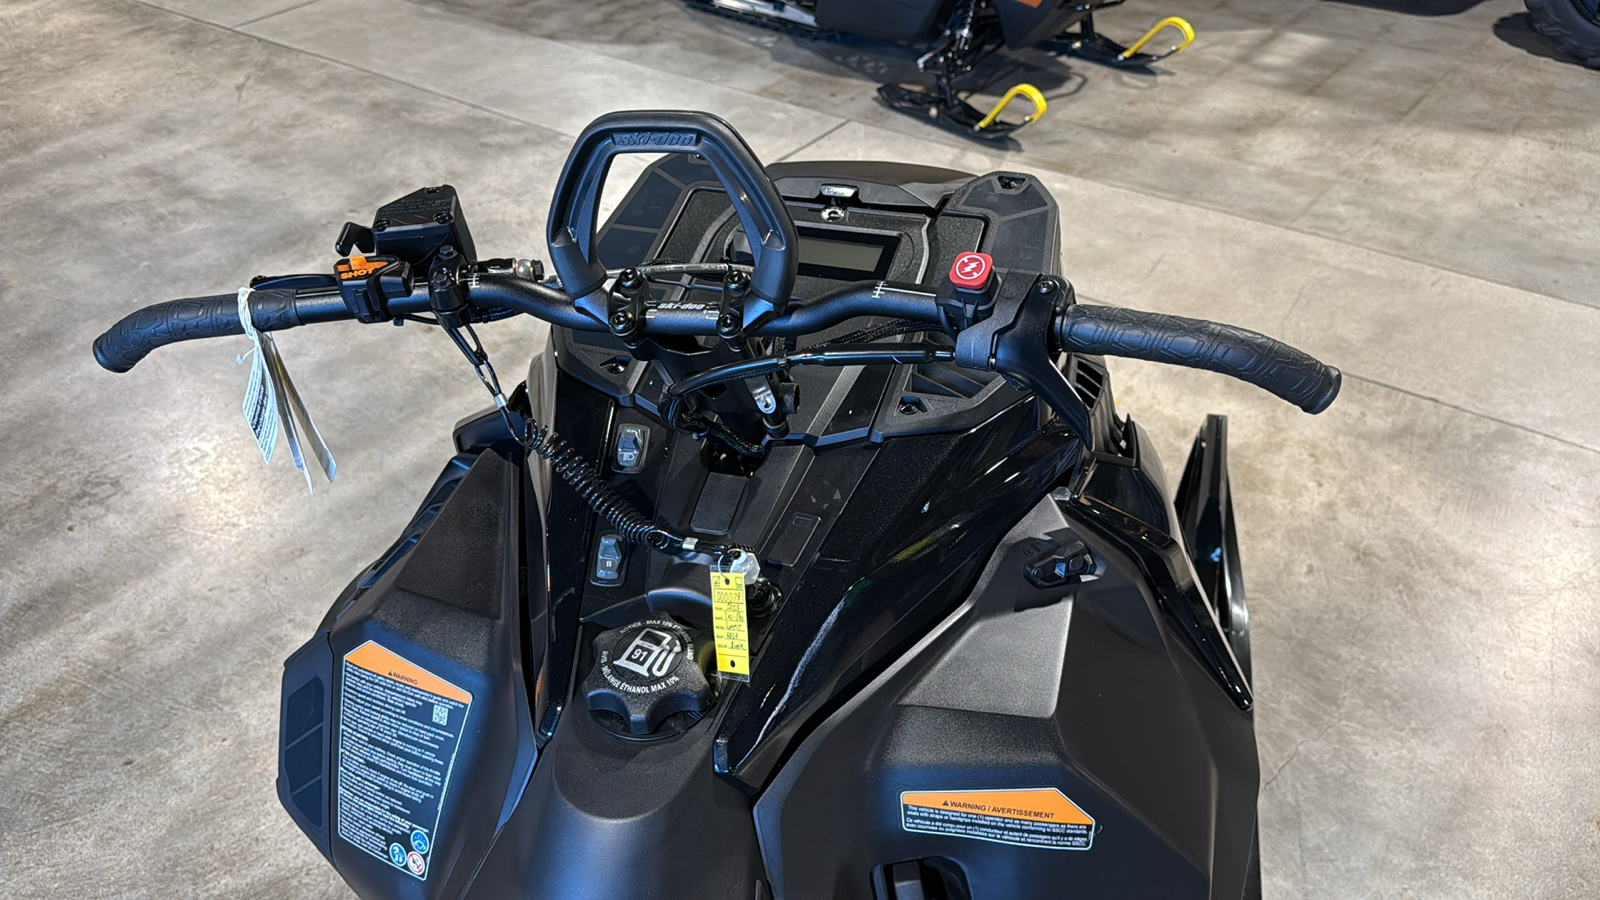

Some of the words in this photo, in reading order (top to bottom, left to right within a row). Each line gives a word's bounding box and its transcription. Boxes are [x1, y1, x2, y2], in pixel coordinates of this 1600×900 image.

[340, 268, 374, 280] SHOT
[657, 302, 705, 310] ski-doo
[620, 622, 642, 634] NOTICE
[631, 648, 648, 662] 91
[392, 671, 418, 685] WARNING
[620, 682, 650, 694] ÉTHANOL
[650, 683, 667, 693] MAX
[666, 674, 680, 686] 10%
[950, 801, 986, 812] WARNING
[992, 806, 1055, 819] AVERTISSEMENT
